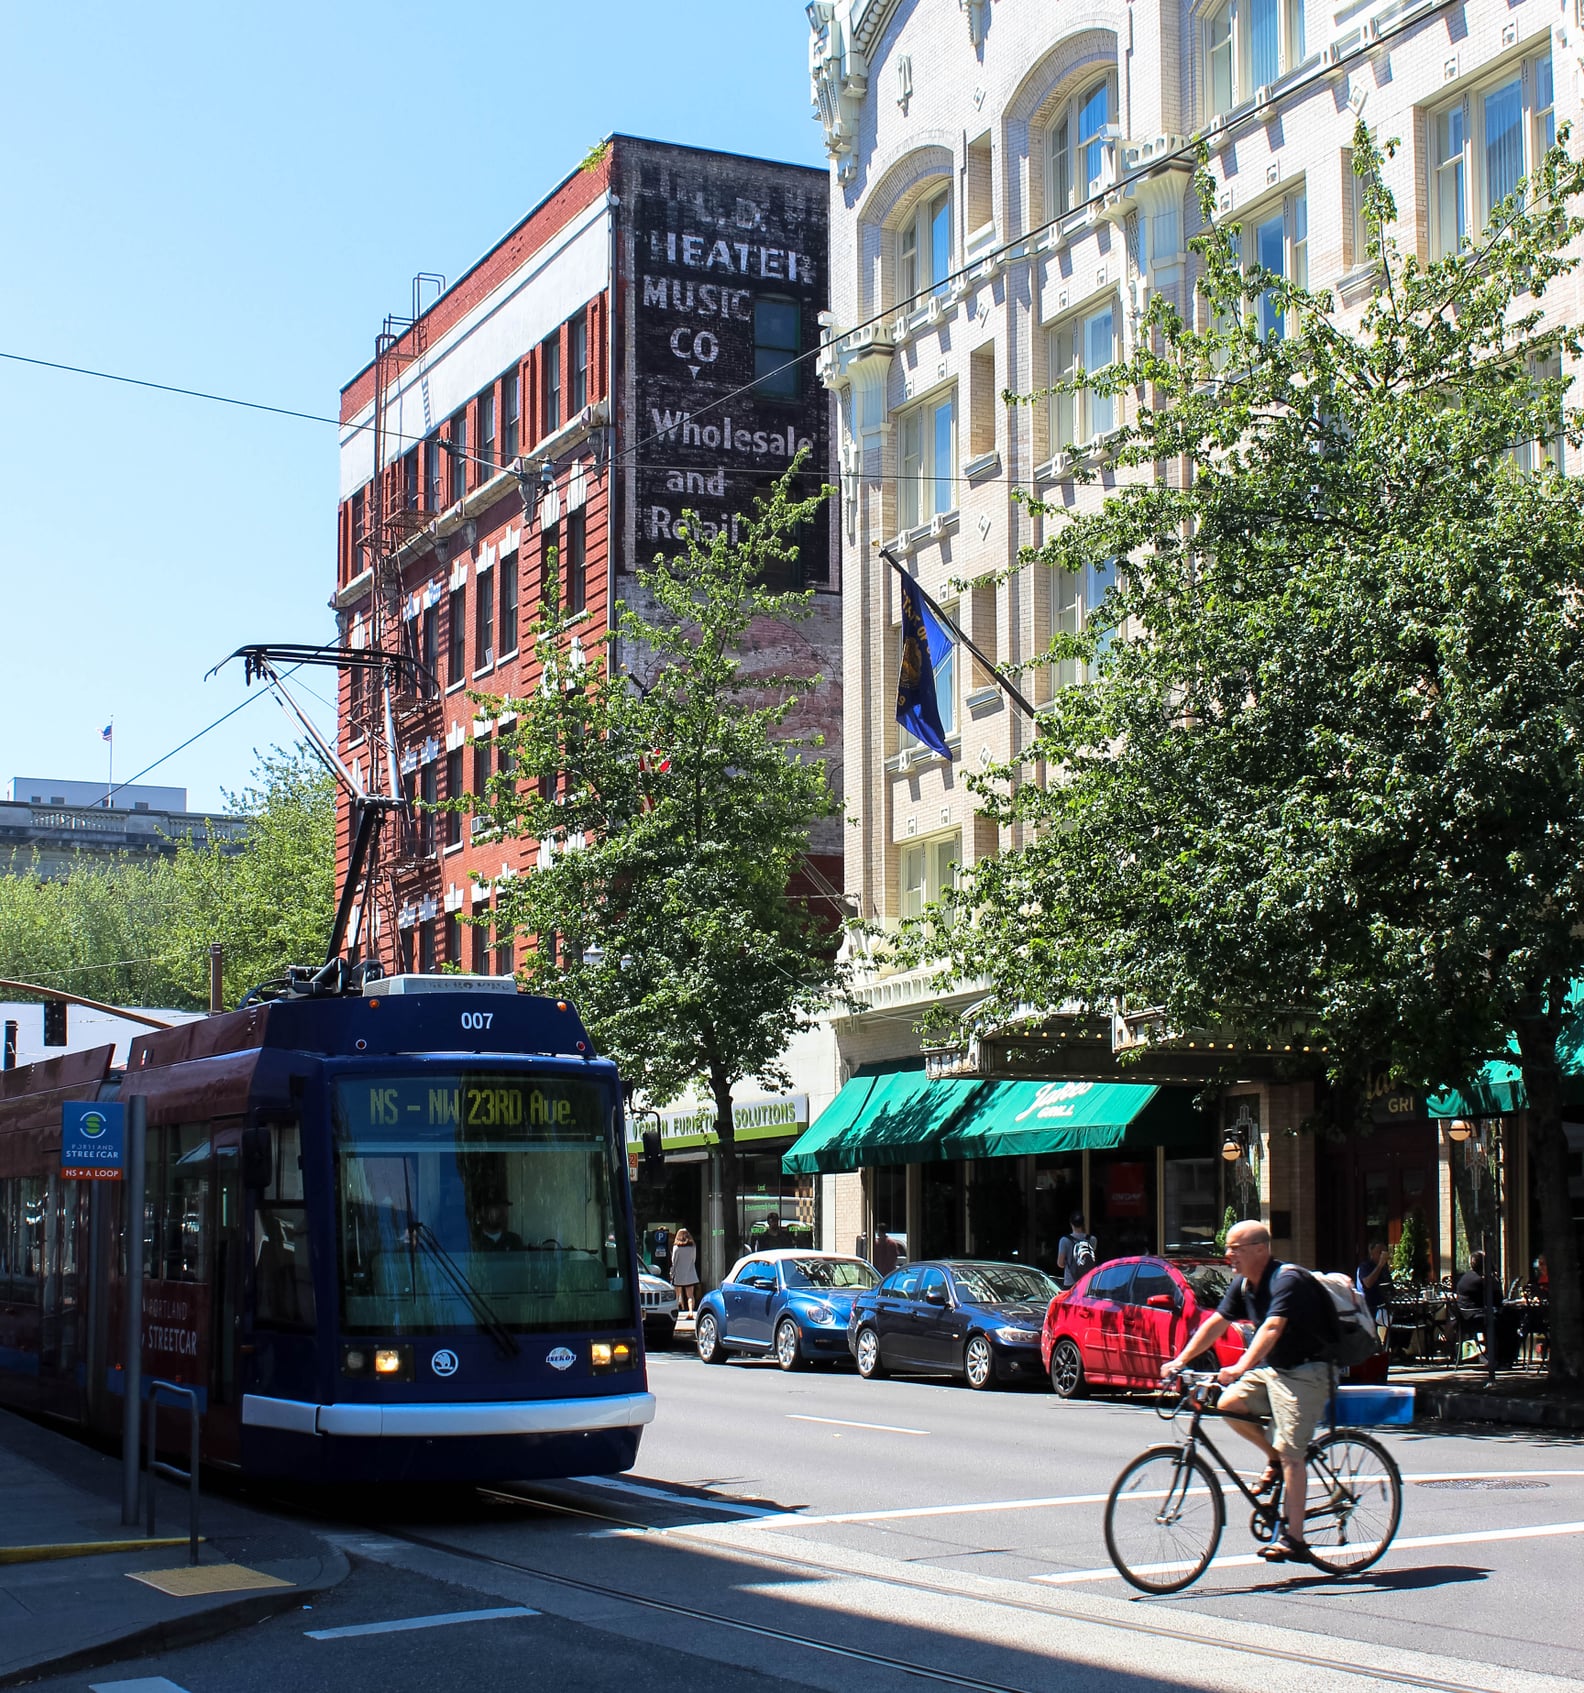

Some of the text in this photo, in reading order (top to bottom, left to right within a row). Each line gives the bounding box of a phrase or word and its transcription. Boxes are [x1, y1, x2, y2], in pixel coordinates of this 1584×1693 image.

[643, 274, 751, 322] MUSIC
[670, 327, 719, 363] CO
[651, 408, 814, 459] Wholesale
[666, 465, 726, 497] and
[461, 1012, 494, 1030] 007
[370, 1088, 398, 1125] NS
[429, 1089, 460, 1125] NW
[467, 1089, 523, 1125] 23RD
[639, 1119, 668, 1139] GREN
[734, 1102, 796, 1129] SOLUTIONS
[1388, 1096, 1414, 1113] GRI
[65, 1169, 77, 1177] NS
[86, 1169, 92, 1177] A
[148, 1325, 197, 1356] STREETCAR
